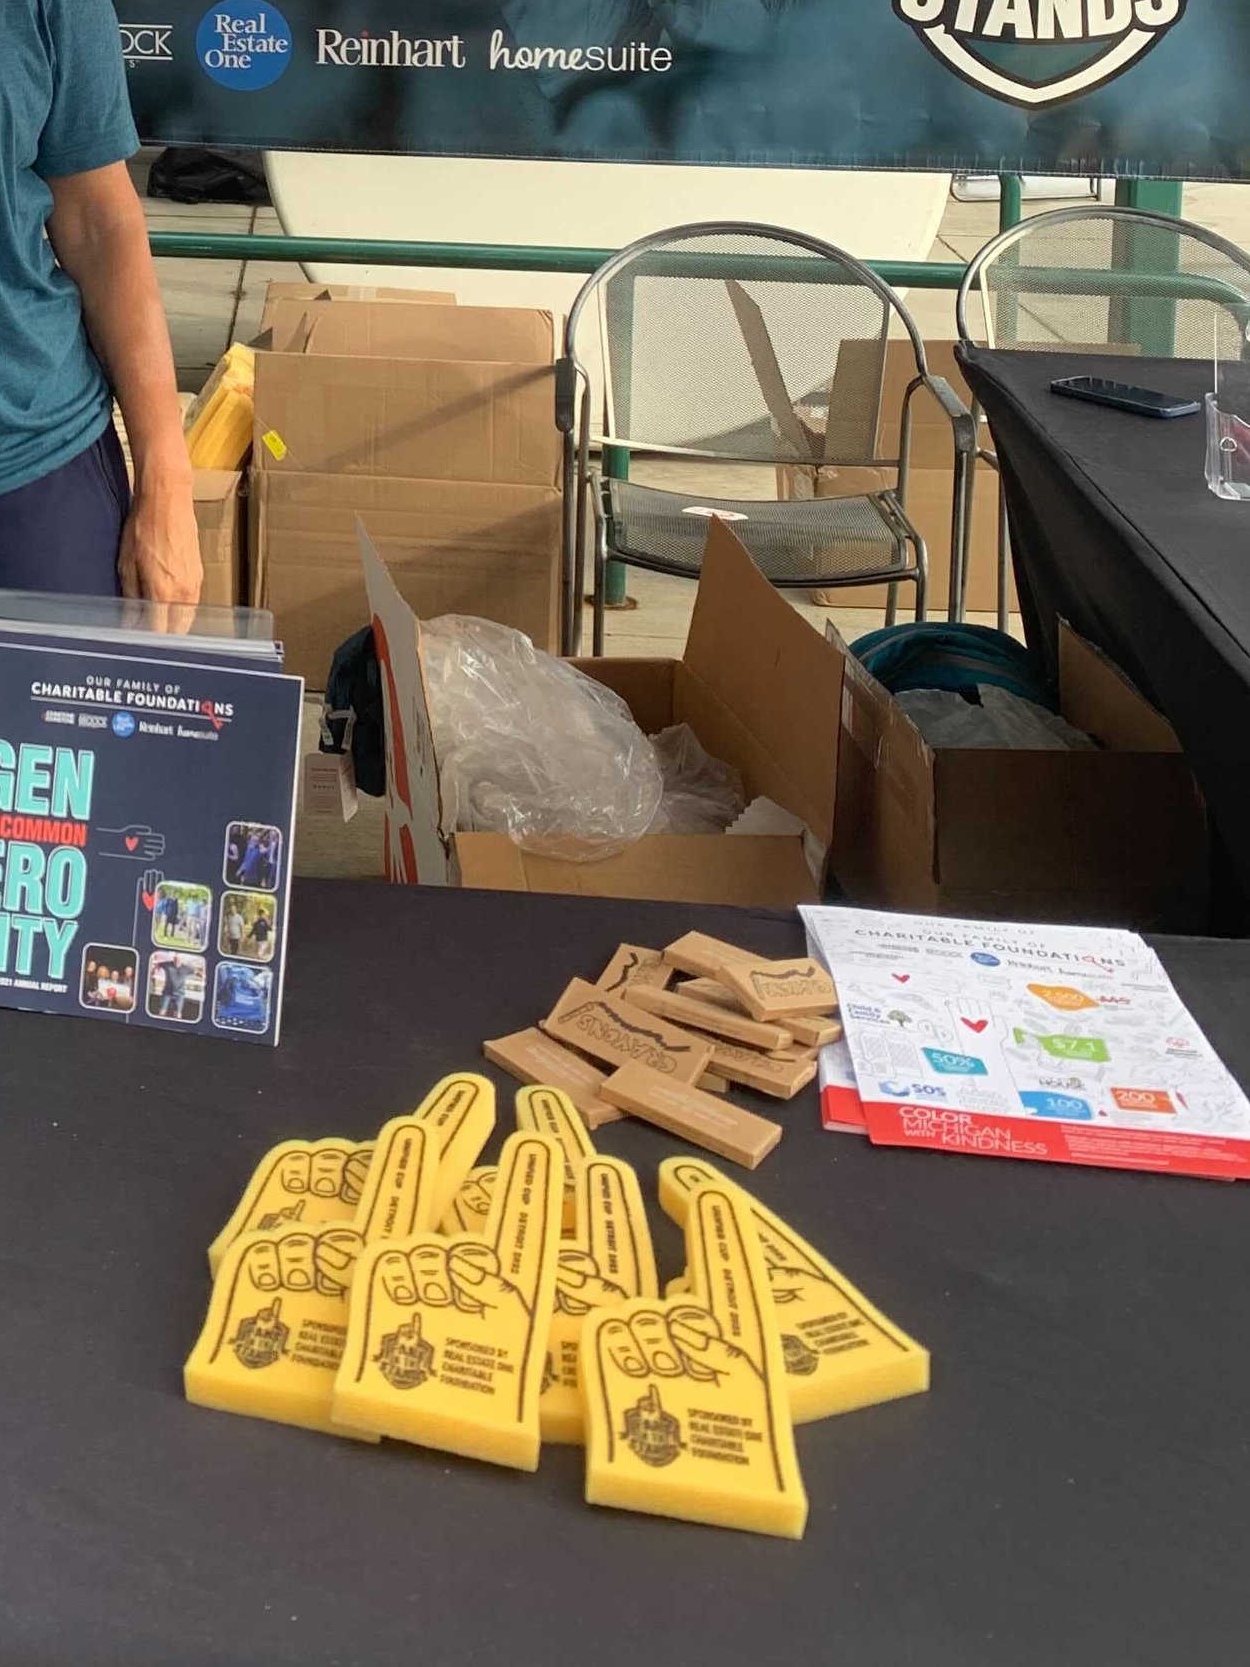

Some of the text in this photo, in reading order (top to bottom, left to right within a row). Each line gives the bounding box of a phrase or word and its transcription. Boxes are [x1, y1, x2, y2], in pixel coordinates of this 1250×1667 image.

[214, 13, 267, 34] Real
[221, 32, 289, 54] Estate
[316, 29, 673, 72] Reinhart homesuite
[204, 49, 252, 69] One
[86, 675, 181, 694] OUR FAMILY OF
[31, 682, 234, 718] CHARITABLE FOUNDATIONS
[854, 929, 976, 949] CHARITABLE
[575, 1015, 678, 1075] CRAYONS
[910, 1083, 947, 1097] SOS
[899, 1106, 973, 1125] COLOR
[903, 1118, 1011, 1139] MICHIGAN
[904, 1128, 1048, 1155] WITH KINDNESS
